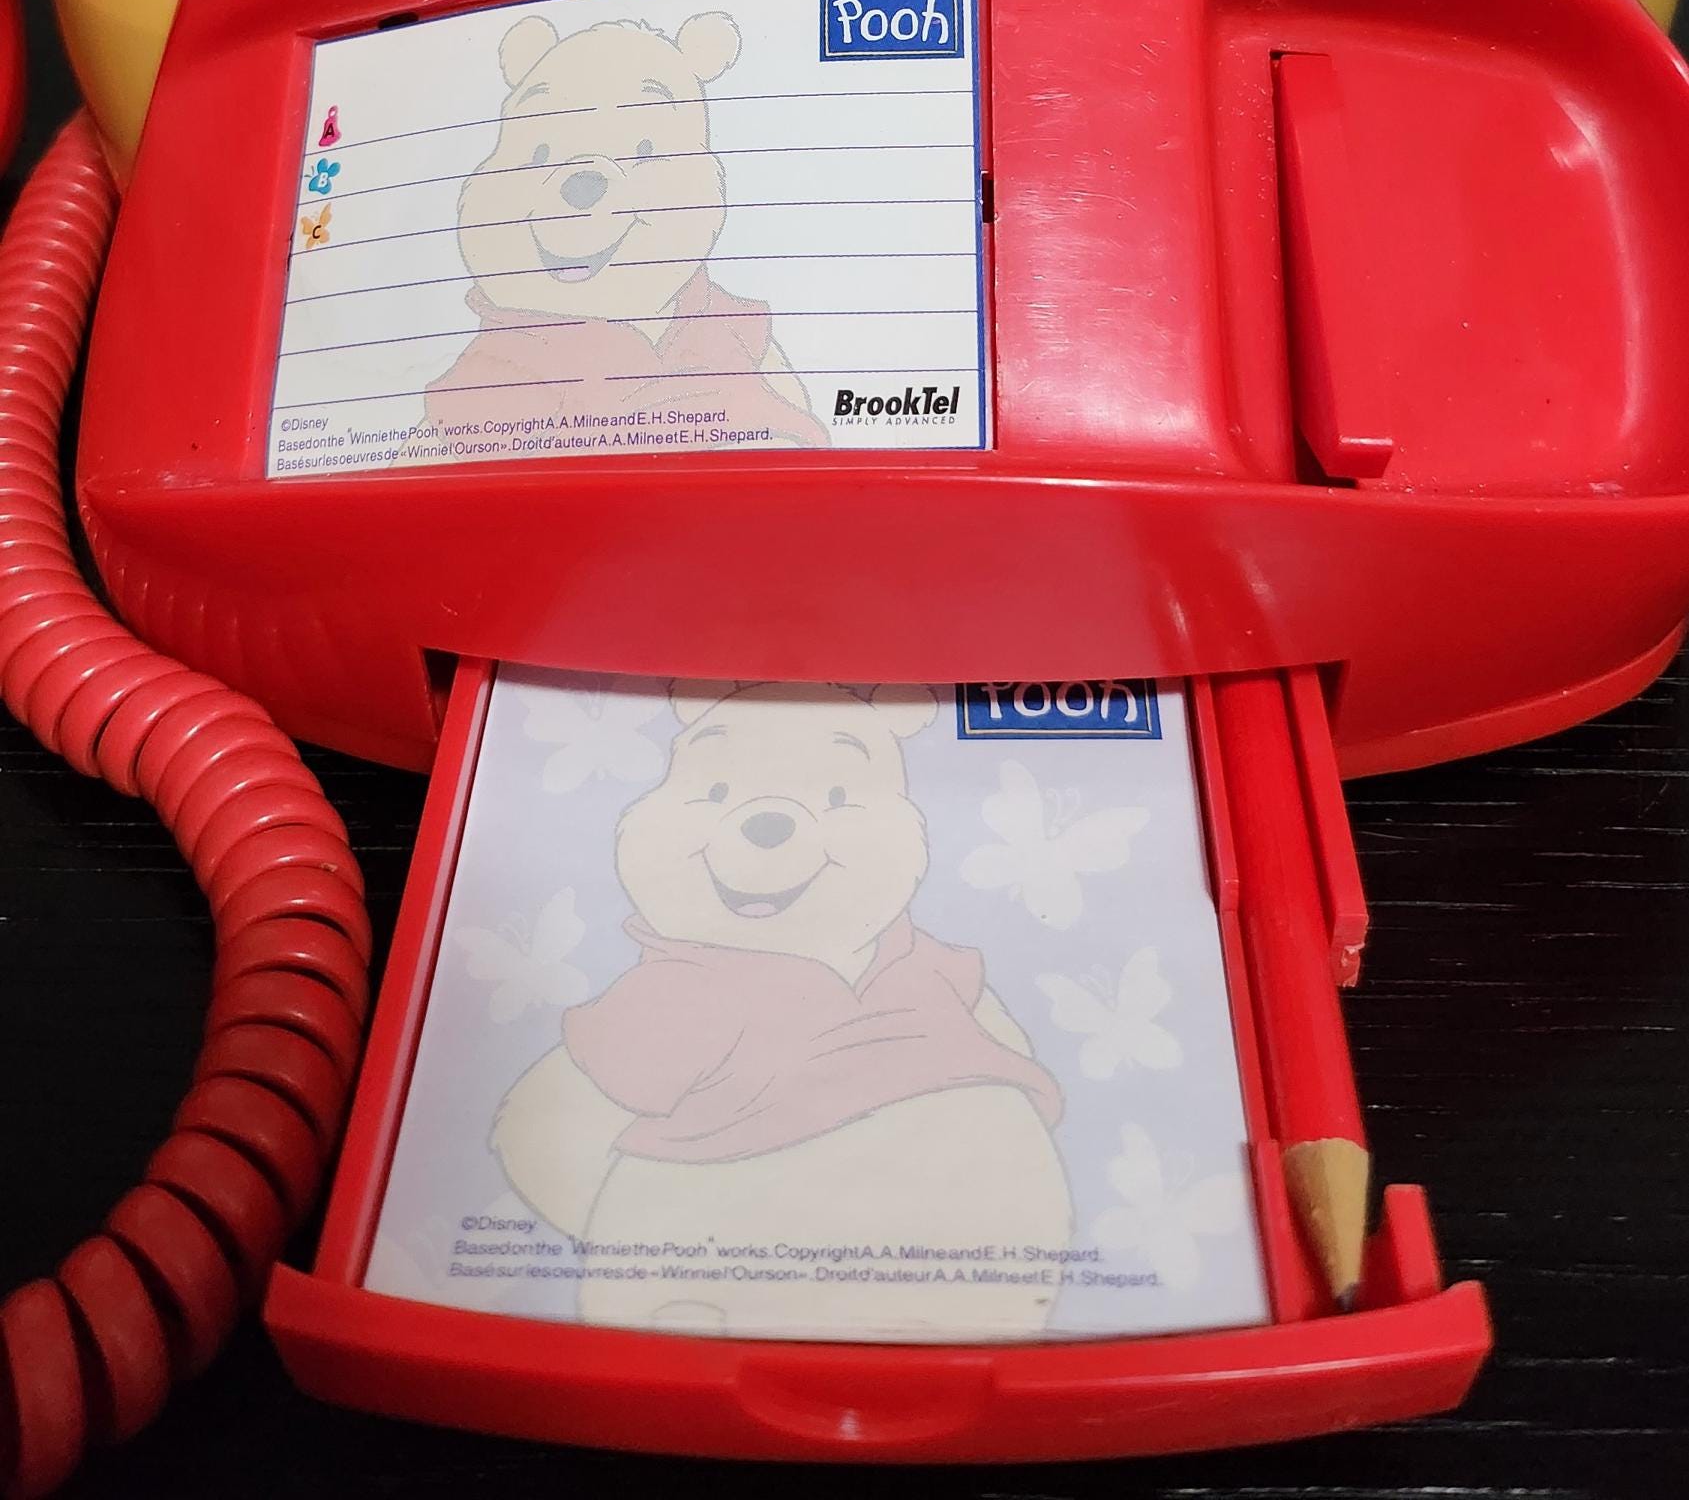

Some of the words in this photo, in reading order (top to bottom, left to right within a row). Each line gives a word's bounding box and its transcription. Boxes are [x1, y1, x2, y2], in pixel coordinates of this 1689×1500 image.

[323, 123, 335, 139] A
[317, 172, 329, 188] B
[312, 225, 322, 239] C
[834, 386, 960, 416] BrookTel
[832, 417, 877, 426] SIMPLY
[885, 416, 956, 426] ADVANCED
